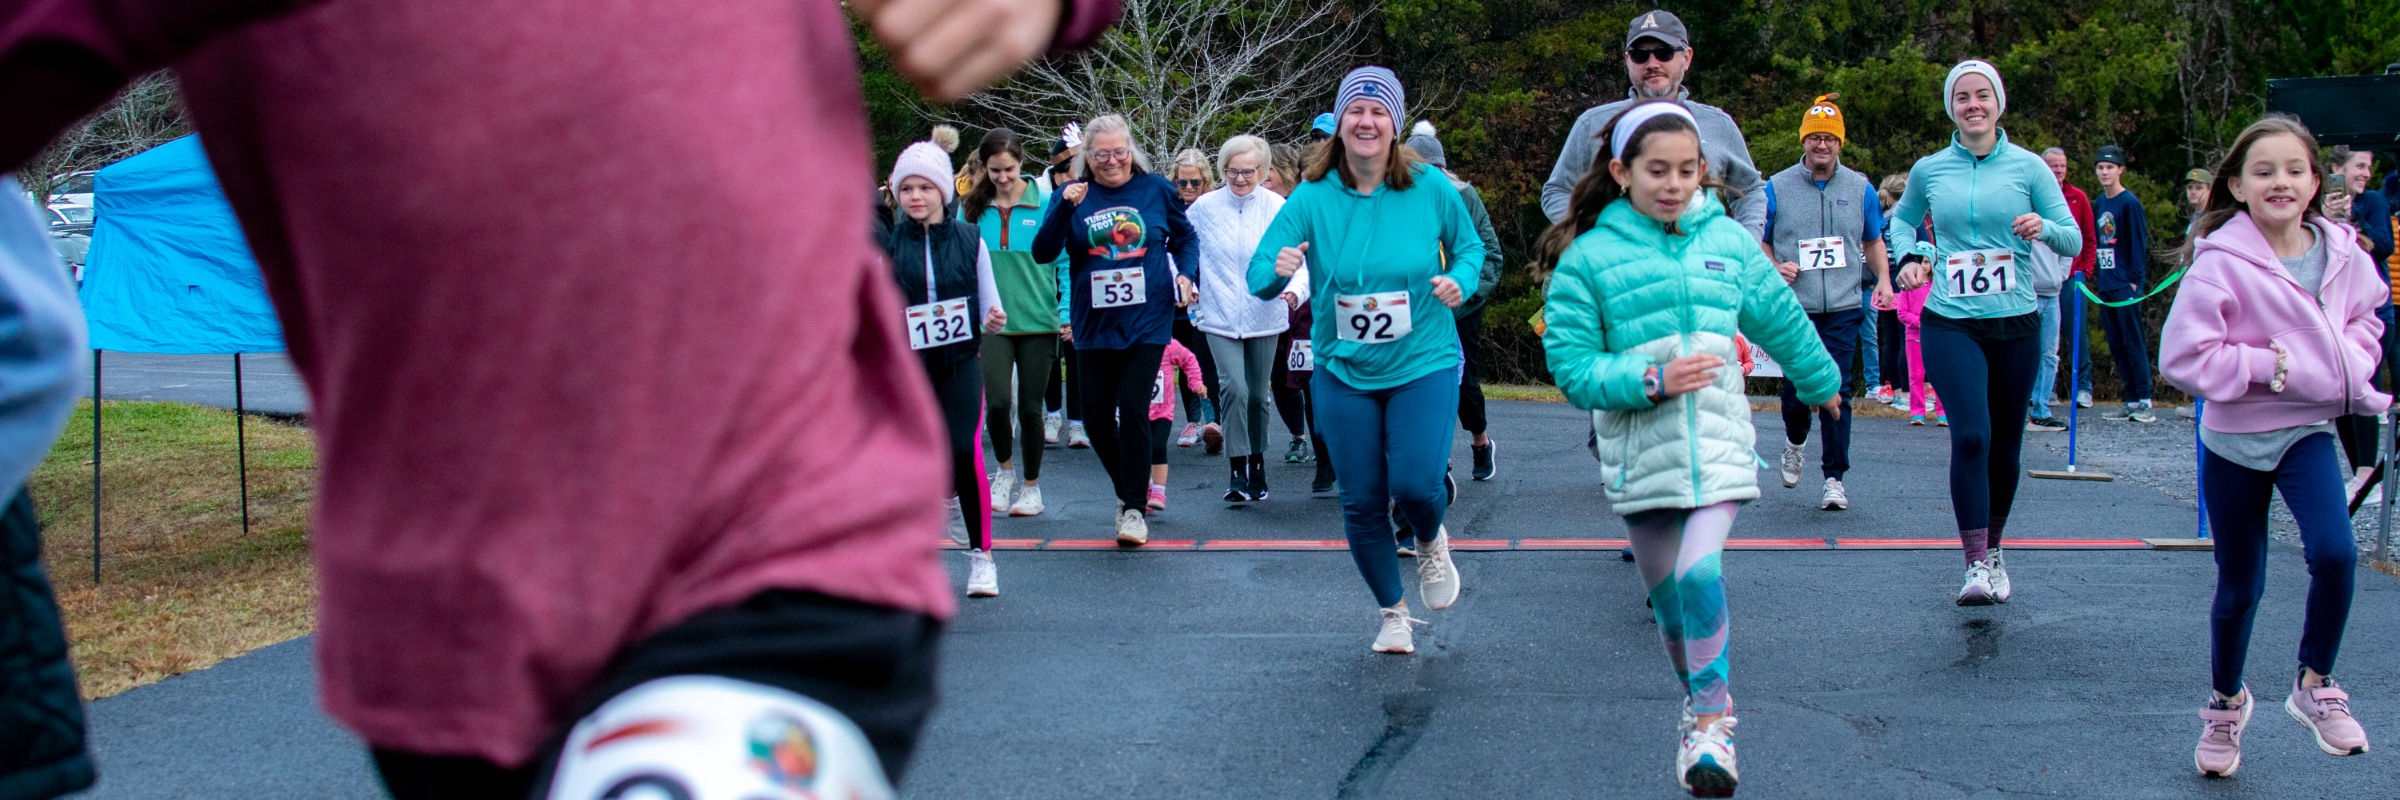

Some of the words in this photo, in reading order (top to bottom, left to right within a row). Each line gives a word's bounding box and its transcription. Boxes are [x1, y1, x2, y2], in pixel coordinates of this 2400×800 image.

[1641, 13, 1659, 30] A
[1083, 211, 1117, 226] TURKEY
[1091, 218, 1114, 232] TROT
[1809, 248, 1836, 268] 75
[1951, 265, 2007, 295] 161
[1104, 282, 1134, 304] 53
[915, 314, 967, 345] 132
[1350, 312, 1394, 340] 92
[1290, 351, 1305, 369] 80
